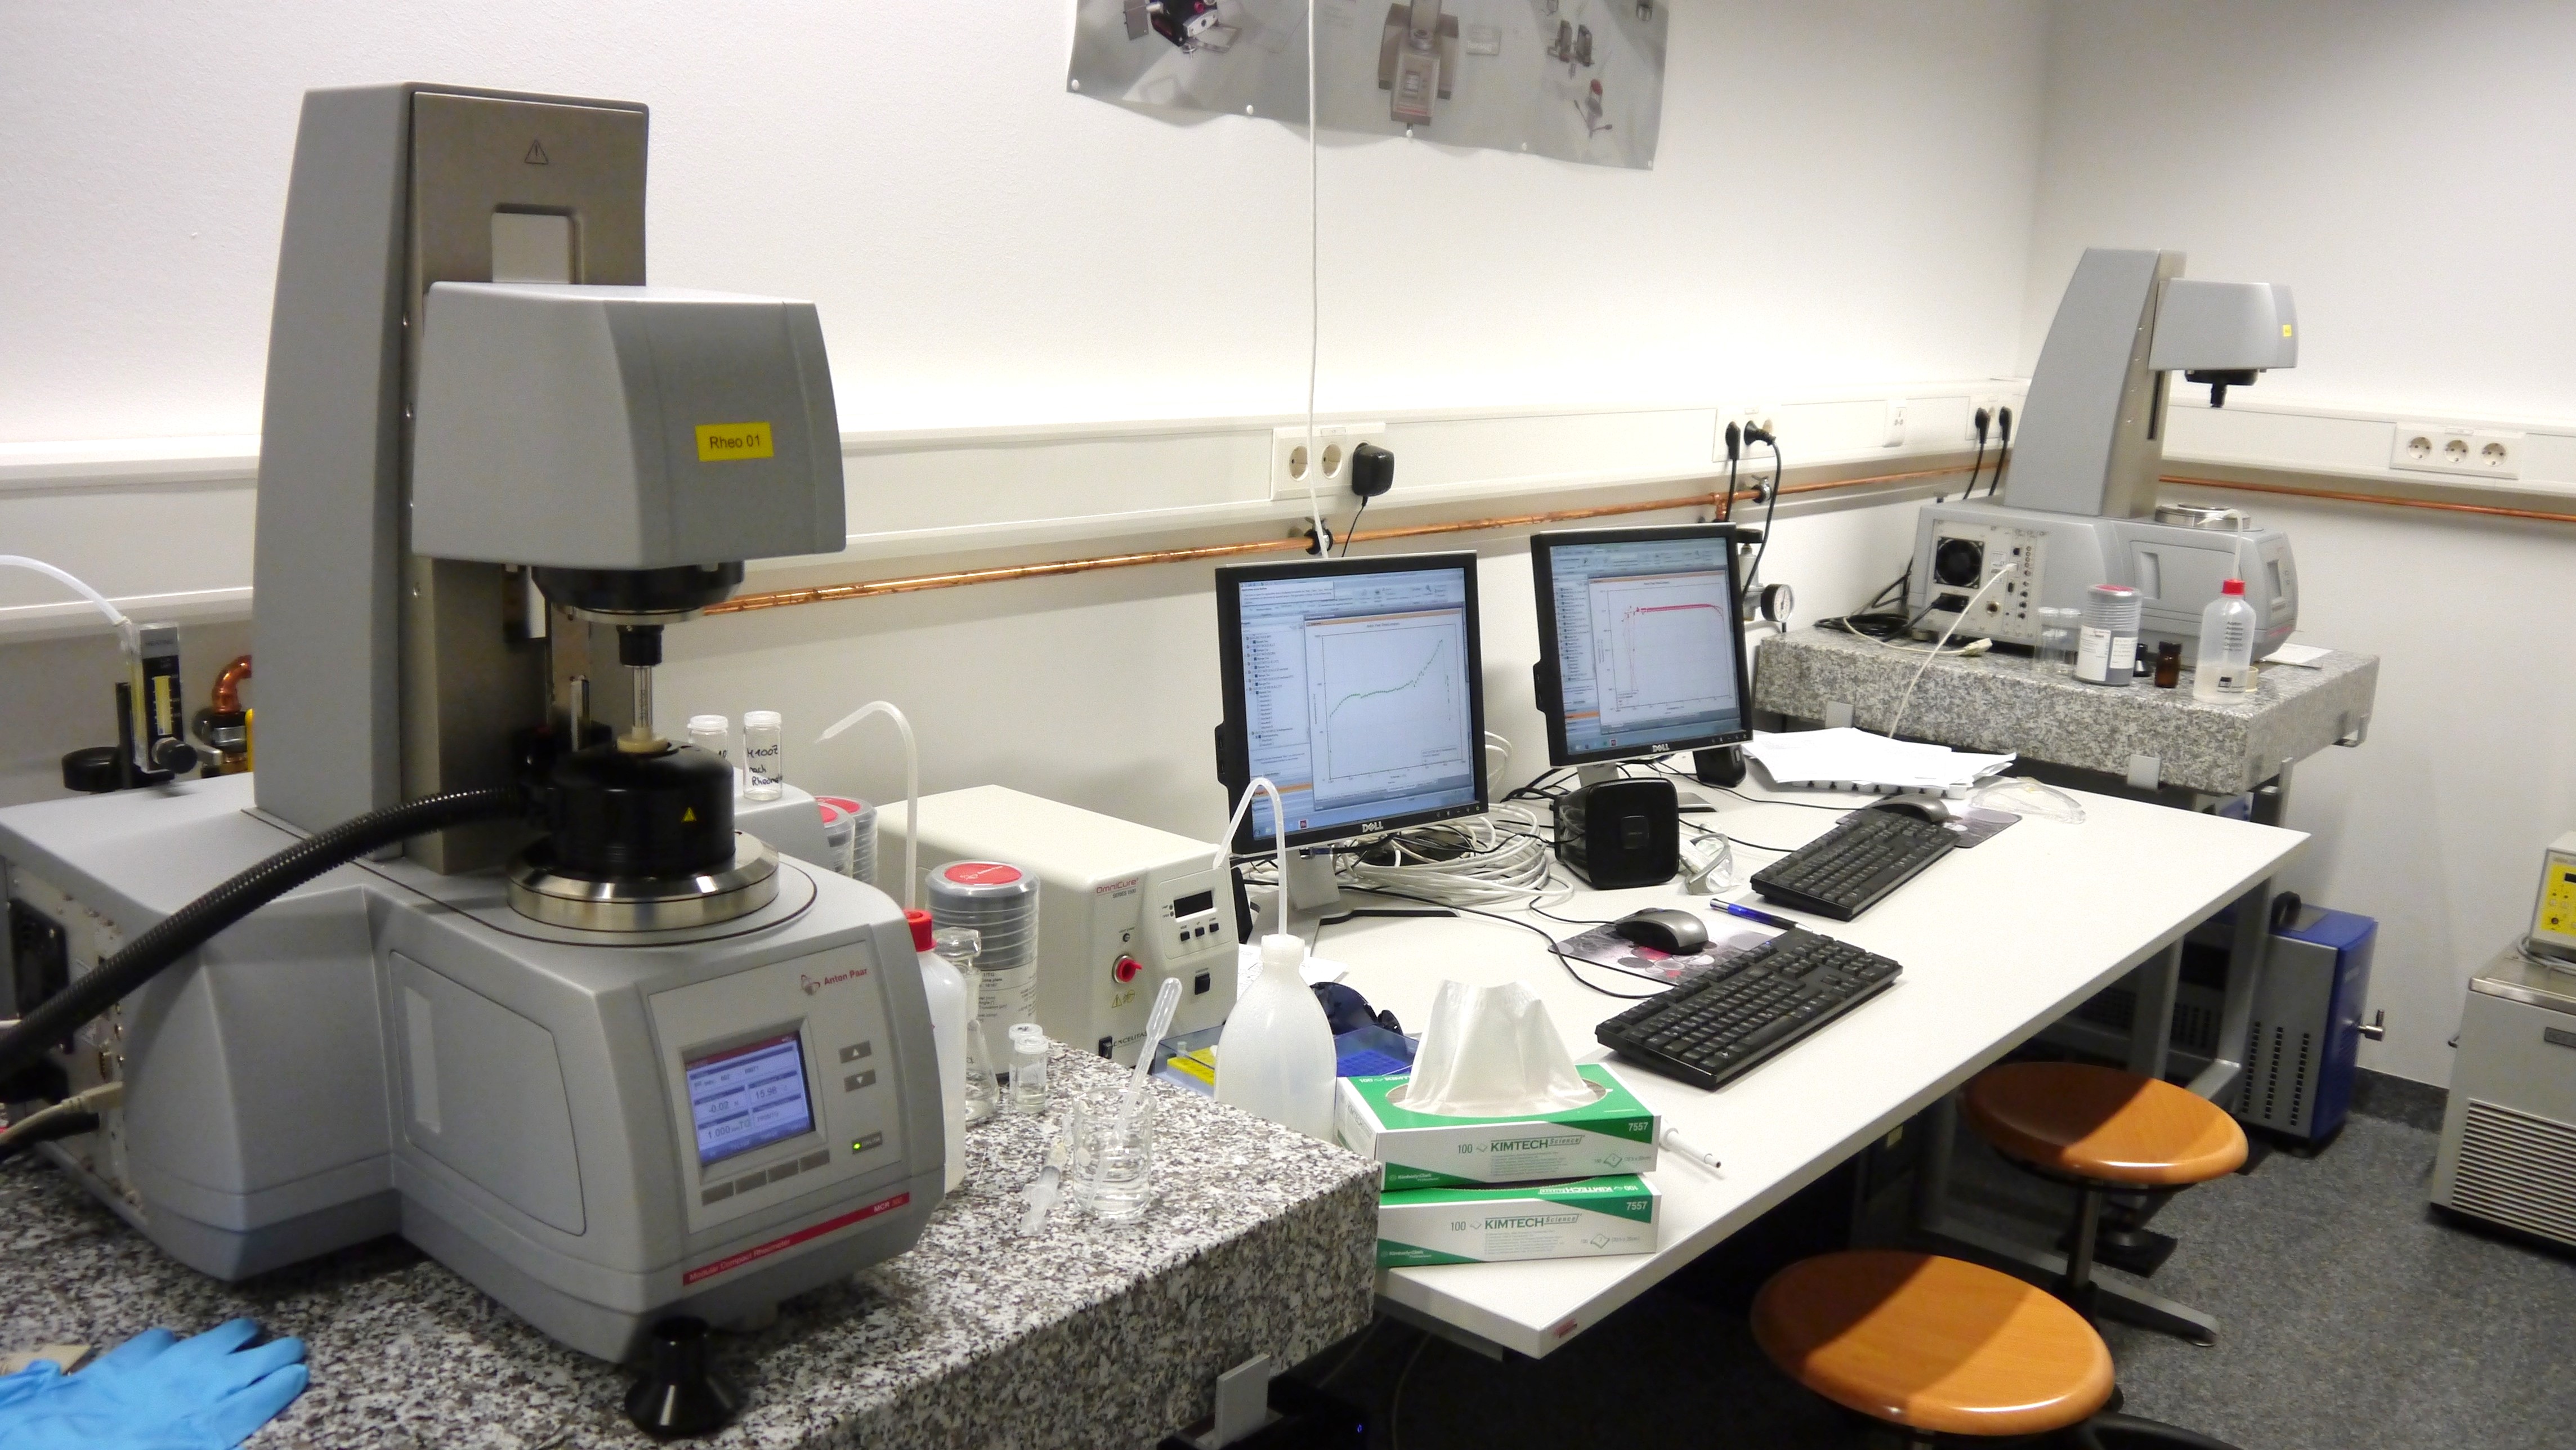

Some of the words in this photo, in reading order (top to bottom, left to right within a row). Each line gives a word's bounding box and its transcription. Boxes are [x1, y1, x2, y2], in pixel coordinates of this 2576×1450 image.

[710, 436, 743, 449] Rheo
[746, 434, 760, 447] 01
[1652, 744, 1670, 753] DELL
[1362, 821, 1384, 833] DELL
[1097, 879, 1137, 894] OmniCure
[825, 974, 847, 985] Anton
[849, 969, 867, 978] Paar
[1628, 1122, 1648, 1132] 7557
[1457, 1144, 1473, 1153] 100
[1491, 1140, 1548, 1152] KIMTECH
[1550, 1136, 1578, 1144] Science
[874, 1201, 890, 1213] MCR
[1626, 1200, 1648, 1211] 7557
[1451, 1221, 1466, 1231] 100
[1484, 1218, 1544, 1229] KIMTECH
